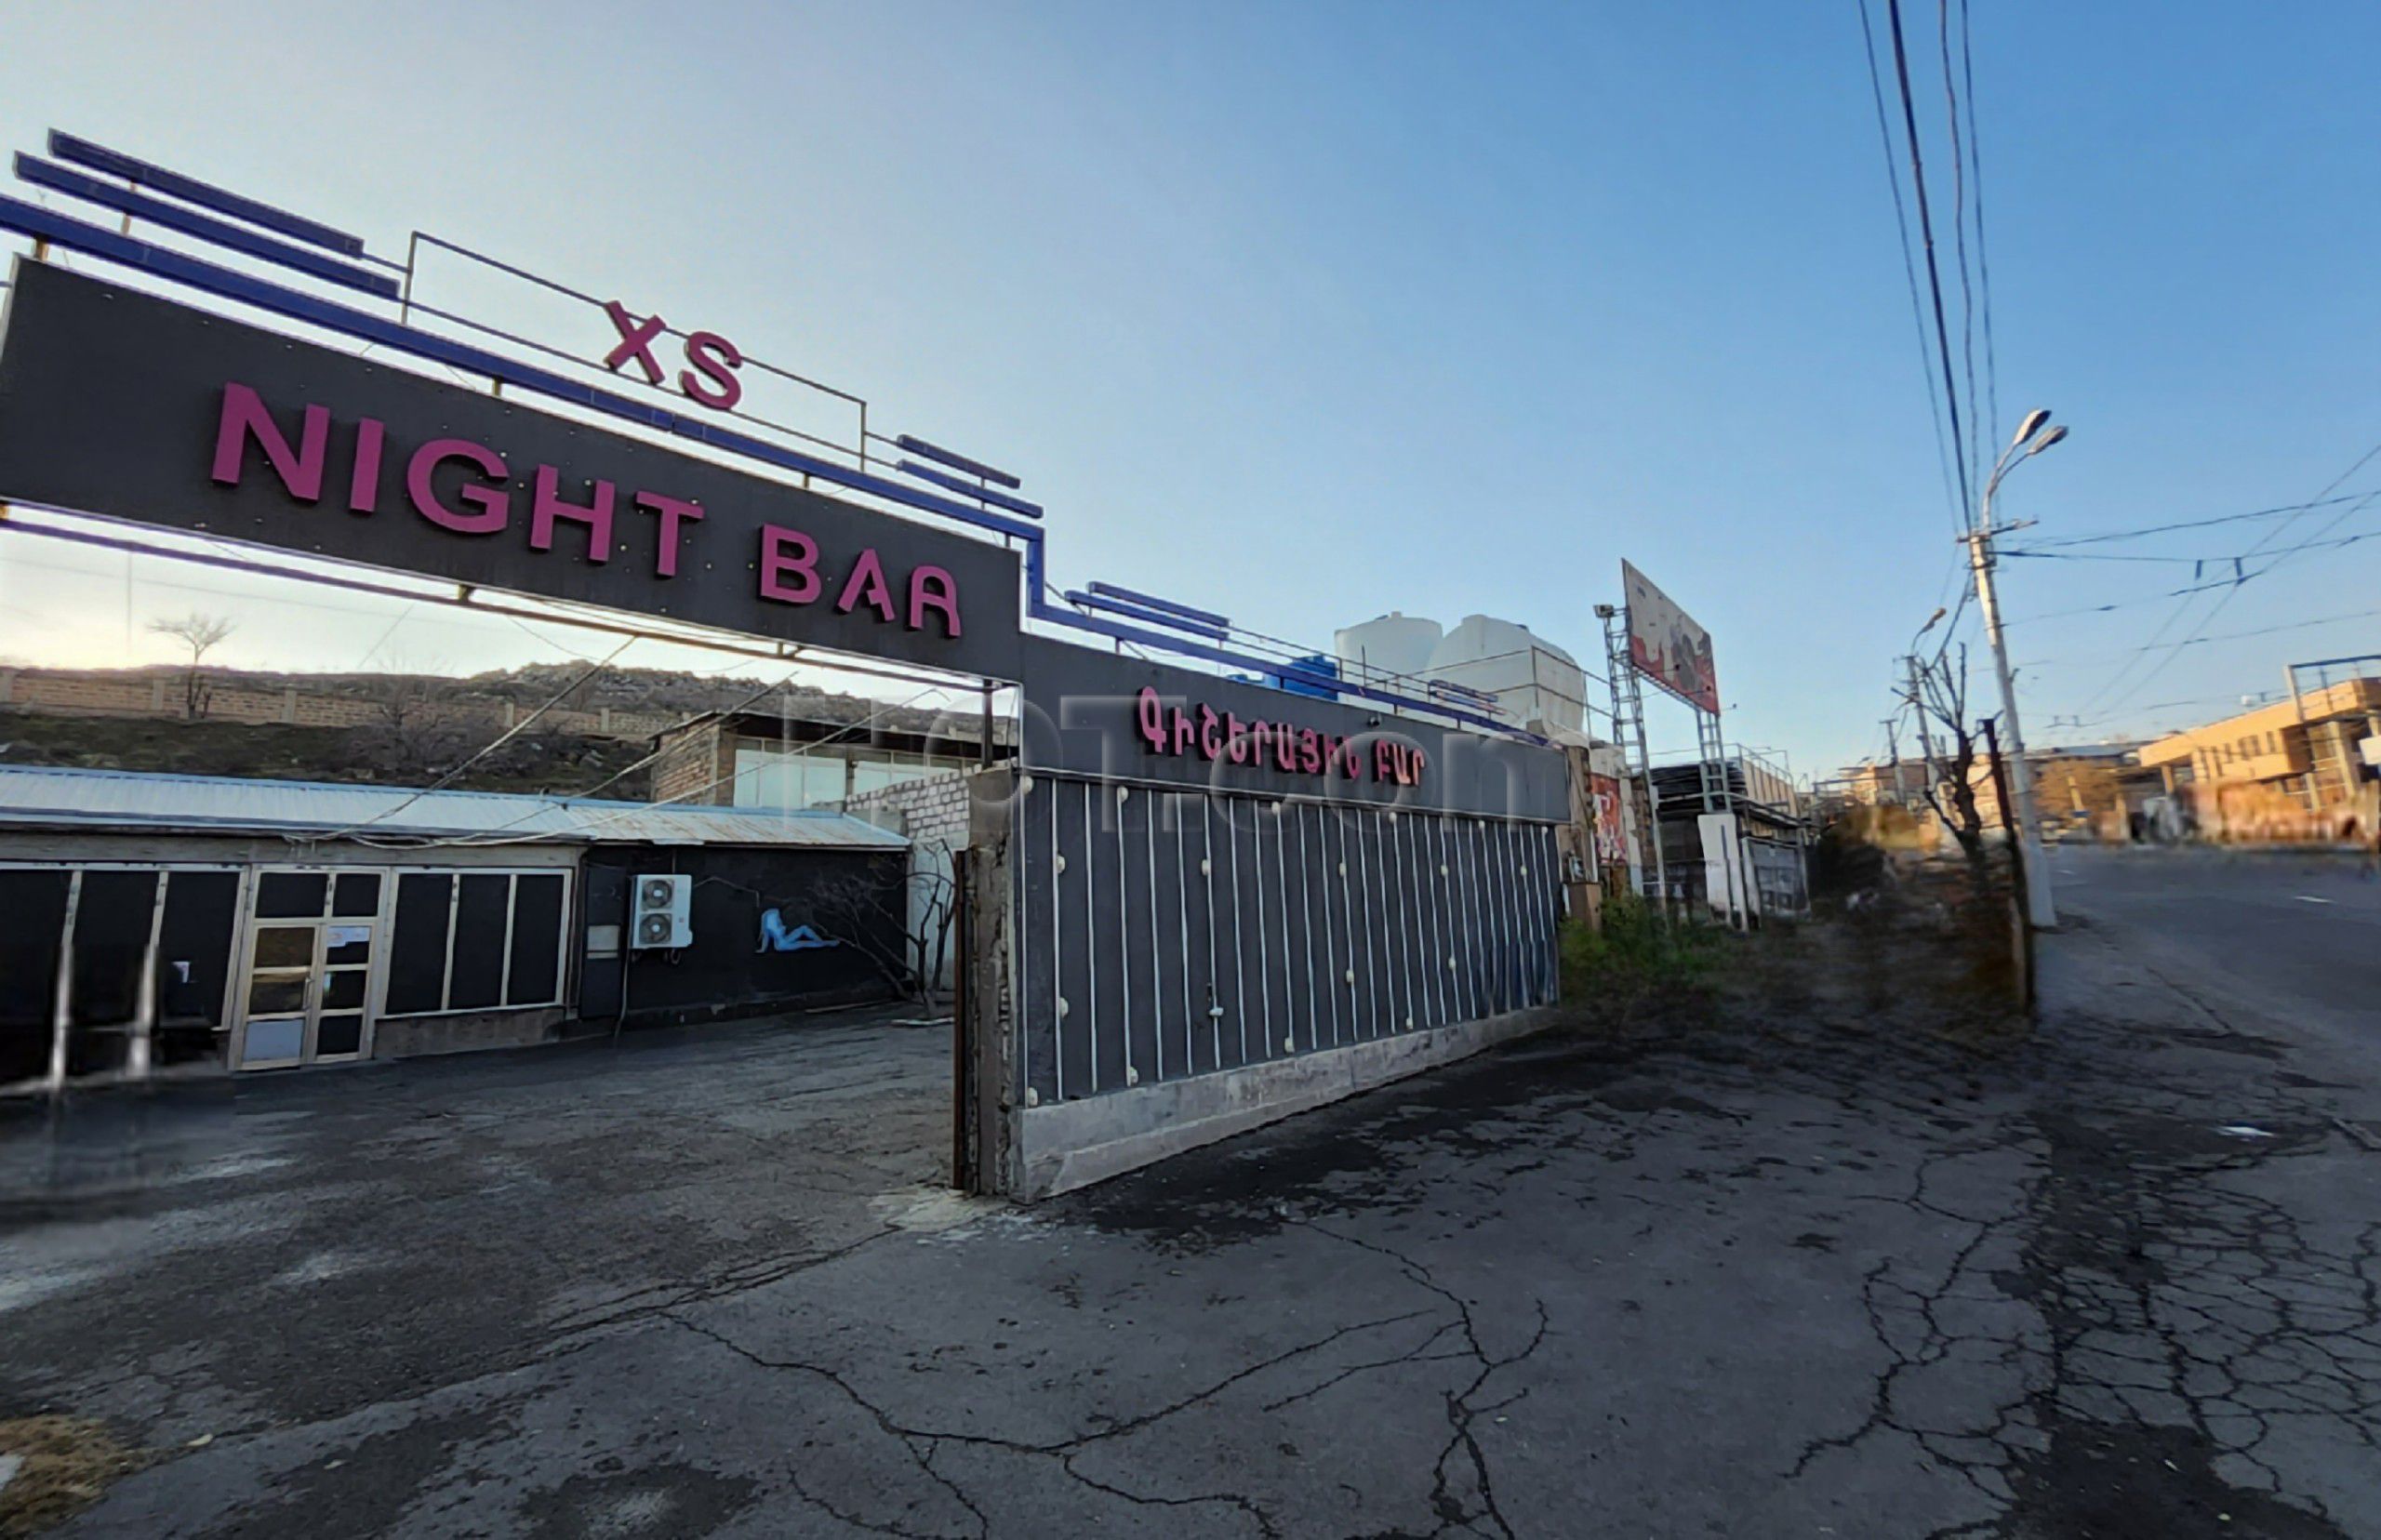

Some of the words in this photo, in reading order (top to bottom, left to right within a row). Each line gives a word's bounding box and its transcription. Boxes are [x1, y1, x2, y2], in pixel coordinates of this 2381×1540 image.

[605, 301, 744, 410] XS
[210, 381, 705, 578] NIGHT
[759, 523, 962, 638] BAR
